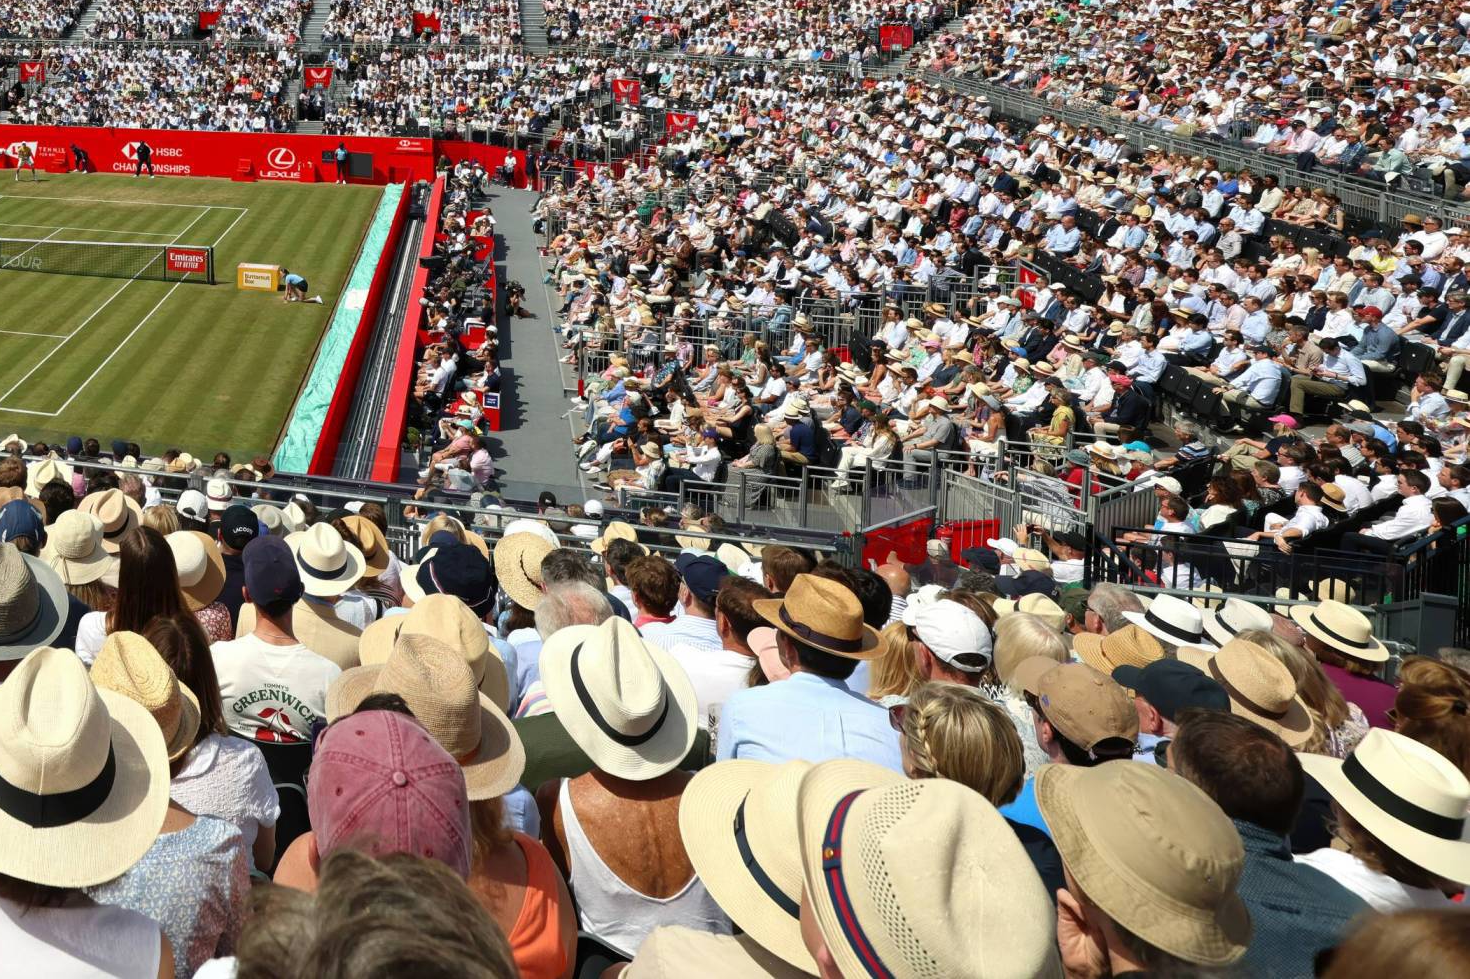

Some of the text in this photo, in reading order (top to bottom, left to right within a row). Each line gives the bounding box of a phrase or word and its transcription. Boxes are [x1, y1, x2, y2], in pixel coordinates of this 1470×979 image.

[156, 148, 182, 157] HSBC
[170, 252, 204, 262] Emirates
[0, 255, 43, 270] TOUR
[263, 682, 290, 691] TOMMY'S
